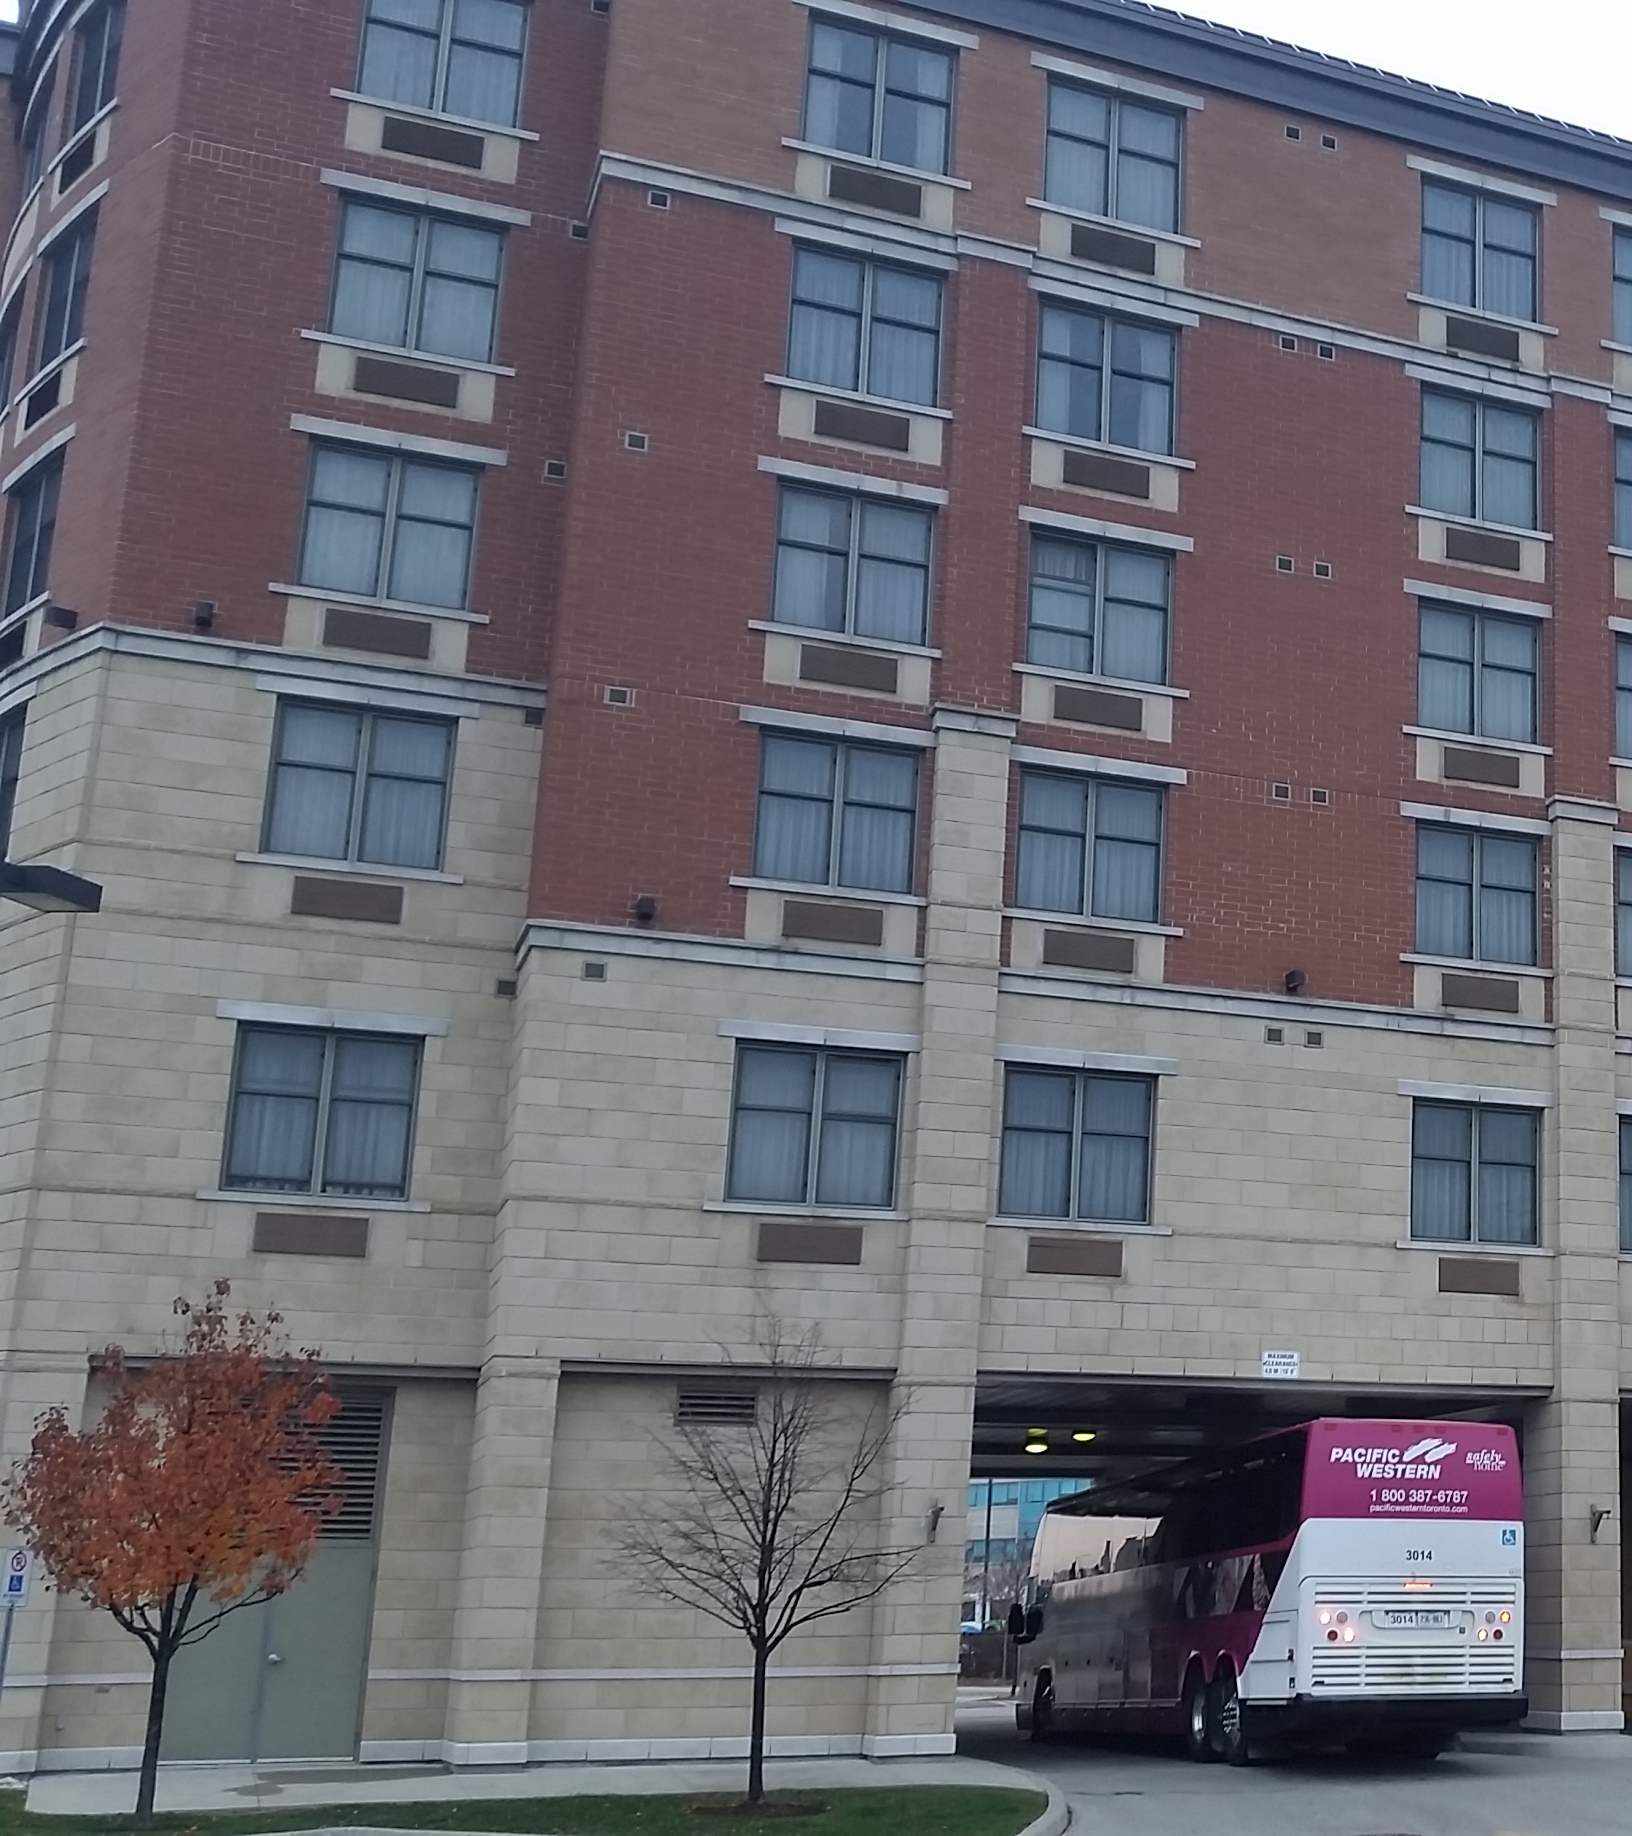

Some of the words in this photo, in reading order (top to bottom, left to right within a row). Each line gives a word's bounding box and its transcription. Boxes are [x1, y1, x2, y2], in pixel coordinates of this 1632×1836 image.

[1329, 1447, 1401, 1463] PACIFIC
[1465, 1448, 1503, 1465] safely
[1355, 1463, 1442, 1480] WESTERN
[1370, 1489, 1377, 1502] 1
[1381, 1489, 1405, 1503] 800
[1408, 1490, 1468, 1504] 387-6787
[1369, 1503, 1468, 1514] pacificwesterntoronto.com
[1405, 1549, 1433, 1561] 3014
[1390, 1614, 1414, 1625] 3014
